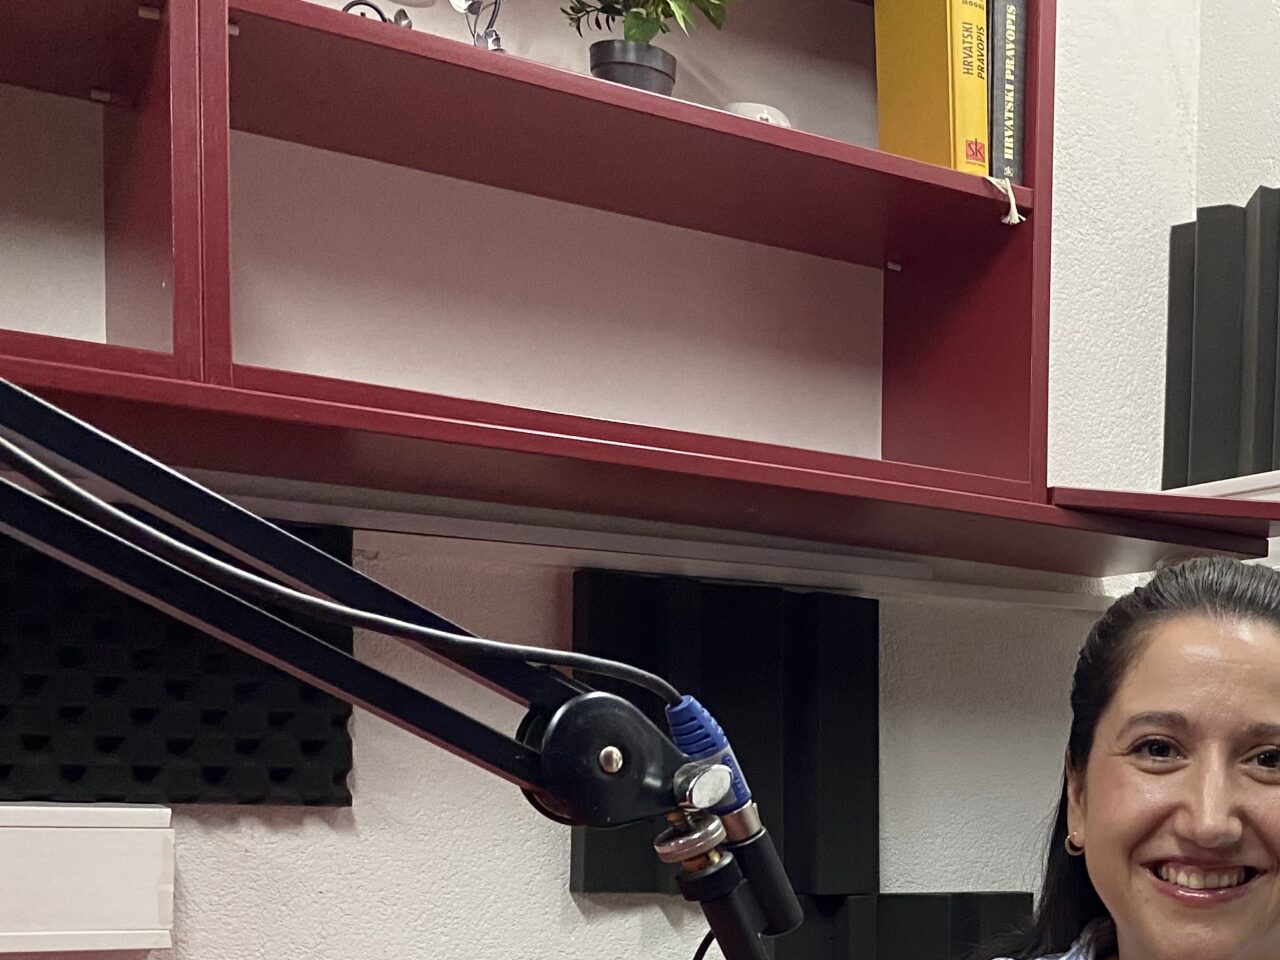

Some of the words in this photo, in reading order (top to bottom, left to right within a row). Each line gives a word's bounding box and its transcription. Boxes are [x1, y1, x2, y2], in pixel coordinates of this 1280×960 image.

[962, 21, 974, 76] HRVATSKI
[976, 25, 985, 80] PRAVOPIS
[1005, 5, 1016, 80] PRAVOPIS
[1004, 83, 1015, 160] HRVATSKI
